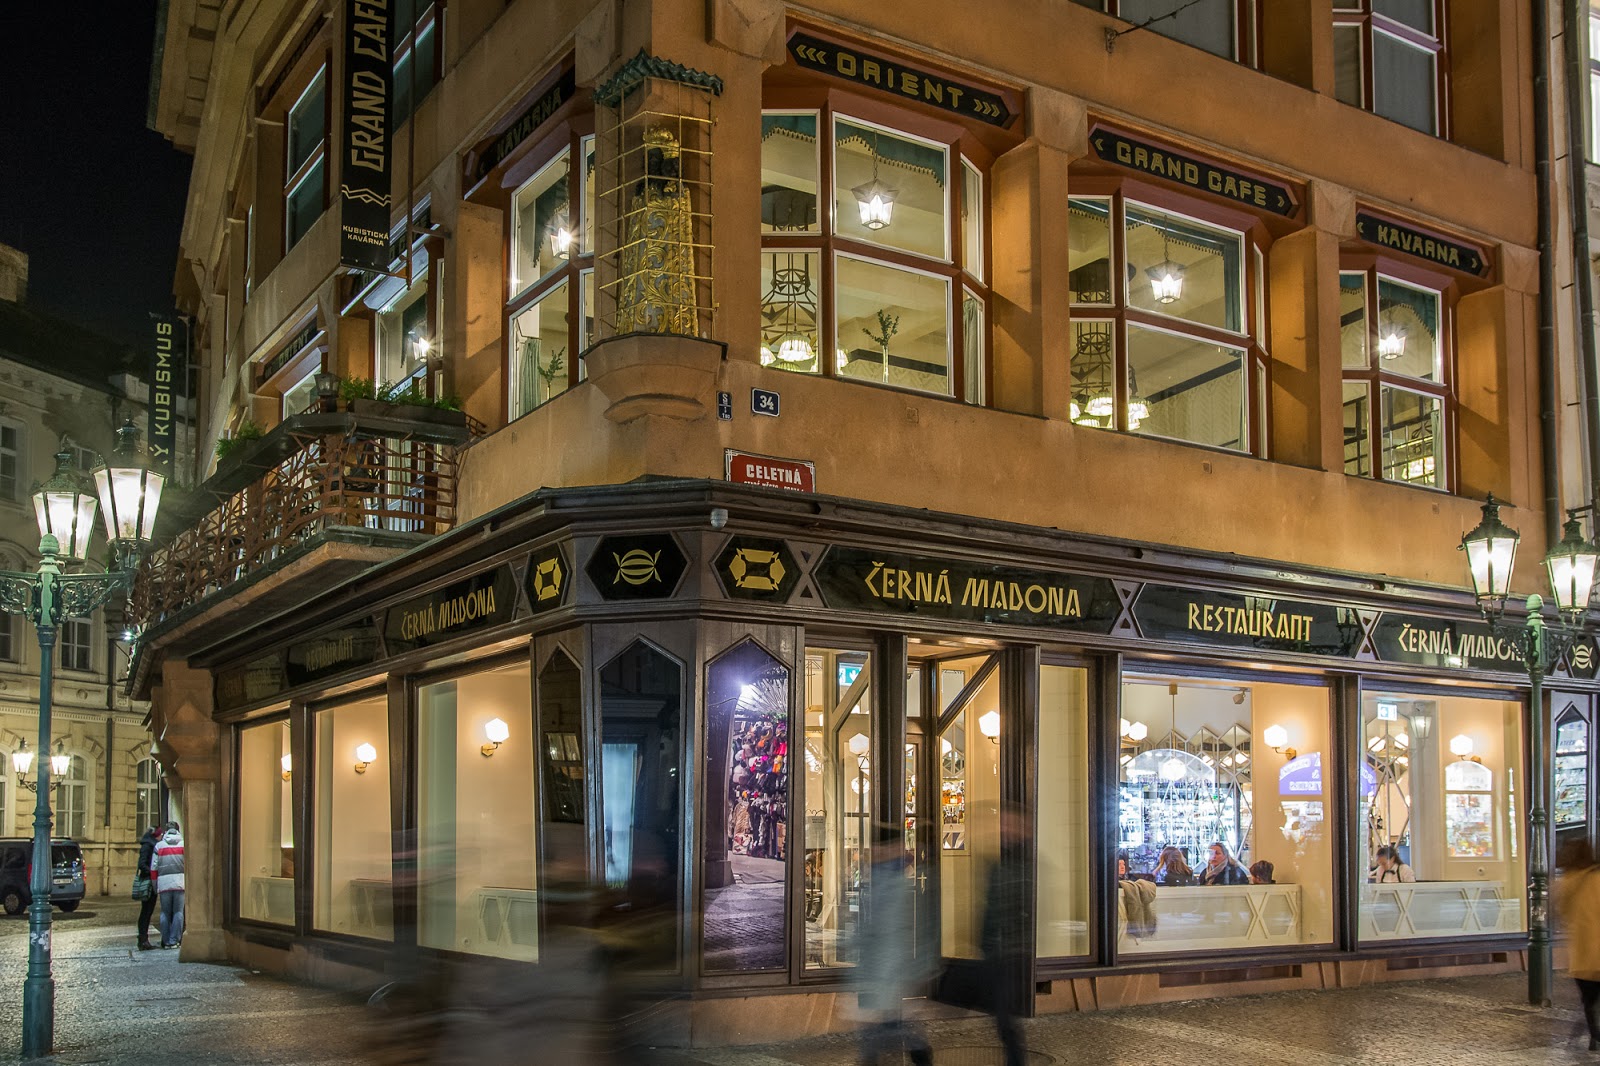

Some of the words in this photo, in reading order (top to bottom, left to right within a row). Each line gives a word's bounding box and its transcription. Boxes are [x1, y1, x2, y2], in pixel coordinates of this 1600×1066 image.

[836, 51, 964, 108] ORIENT
[351, 70, 387, 173] GRAND
[1116, 141, 1199, 185] GRAND
[1208, 170, 1267, 206] CAFE
[342, 225, 389, 240] KUBISTICKÁ
[347, 233, 385, 247] KAVÁRNA
[1377, 224, 1460, 266] KAVARNA
[155, 322, 173, 436] KUBISMUS
[759, 395, 775, 410] 34
[745, 463, 802, 486] CELETNÁ
[865, 560, 952, 605] ČERNÁ
[961, 577, 1082, 618] MADONA
[401, 601, 435, 640] ČERNÁ
[438, 585, 496, 630] MADONA
[1188, 602, 1314, 642] RESTAURANT
[1398, 623, 1453, 656] ČERNÁ
[1457, 633, 1526, 662] MADON
